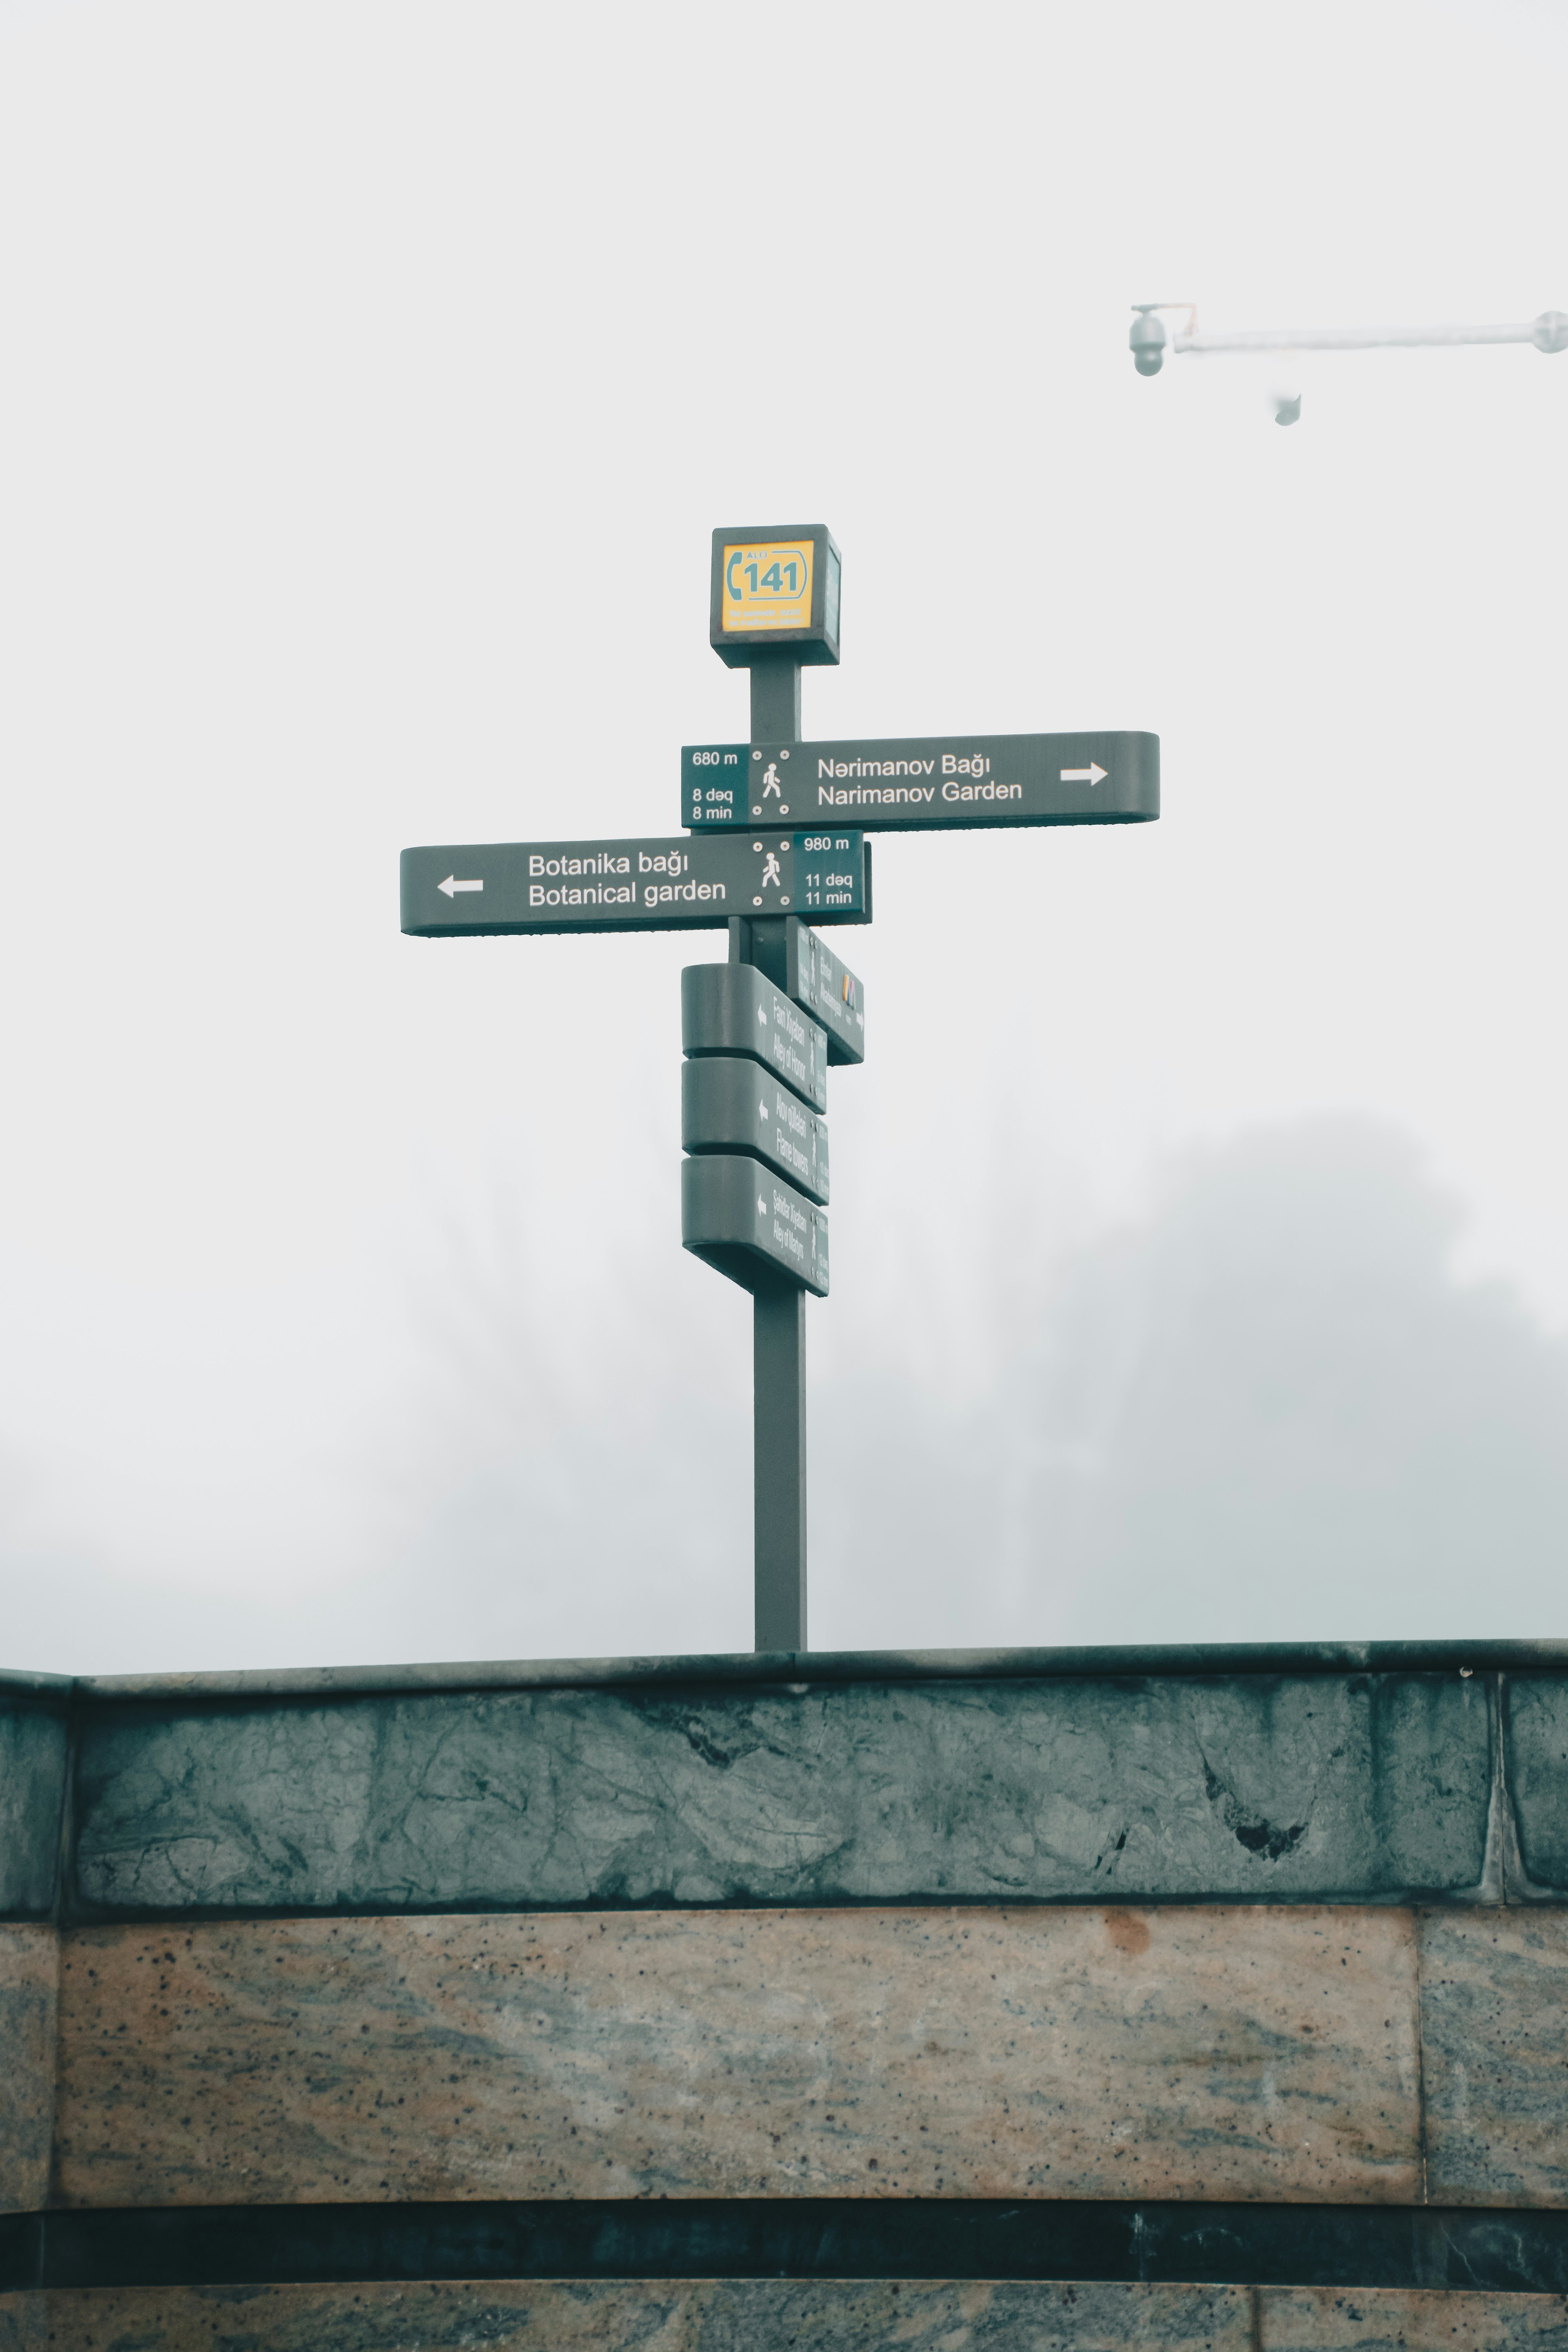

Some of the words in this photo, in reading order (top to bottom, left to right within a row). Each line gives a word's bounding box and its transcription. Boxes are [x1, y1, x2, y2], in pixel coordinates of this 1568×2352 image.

[746, 551, 768, 559] ALO
[744, 562, 797, 592] 141
[693, 751, 720, 765] 680
[724, 754, 737, 765] m
[818, 758, 935, 779] Nərimanov
[942, 754, 990, 778] Bağı
[693, 788, 702, 802] 8
[706, 788, 733, 804] dəq
[818, 785, 935, 805] Narimanov
[942, 780, 1022, 802] Garden
[693, 806, 702, 820] 8
[706, 806, 732, 819] min
[804, 837, 831, 851] 980
[836, 839, 849, 850] m
[529, 853, 630, 877] Botanika
[639, 851, 688, 877] bağı
[806, 873, 819, 887] 11
[826, 873, 853, 888] dəq
[530, 882, 636, 906] Botanical
[644, 880, 726, 907] garden
[806, 891, 819, 905] 11
[826, 891, 852, 904] min
[774, 1033, 785, 1069] Alley
[786, 1045, 791, 1069] of
[792, 1048, 806, 1082] Honor
[777, 1092, 787, 1122] Alov
[777, 1127, 792, 1162] Flame
[793, 1142, 808, 1176] towers
[773, 1219, 784, 1249] Alley
[784, 1228, 789, 1247] of
[789, 1230, 804, 1261] Martyrs
